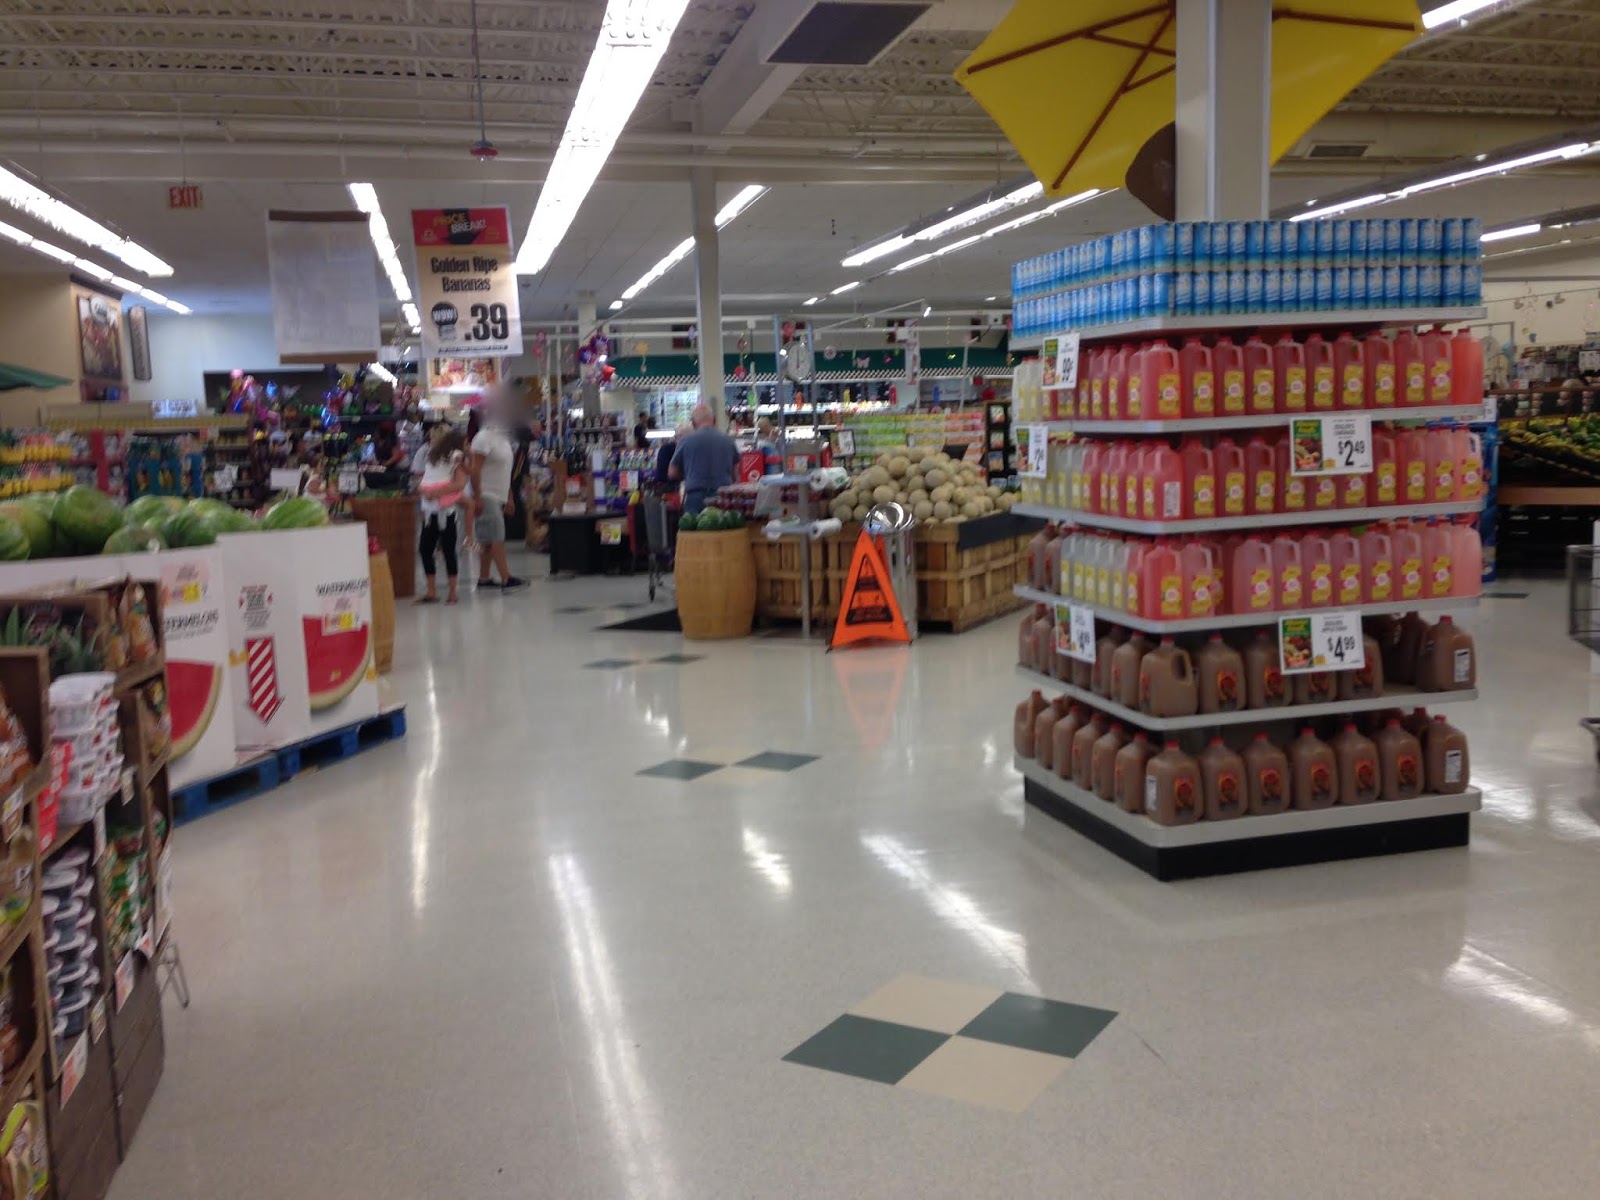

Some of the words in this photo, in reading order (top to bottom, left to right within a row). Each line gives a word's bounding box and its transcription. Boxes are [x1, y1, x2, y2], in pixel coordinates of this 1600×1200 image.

[169, 185, 199, 208] EXIT
[451, 219, 487, 234] BREAK!
[431, 256, 470, 273] Golden
[472, 257, 499, 274] Ripe
[442, 276, 492, 293] Bananas
[464, 303, 509, 341] .39
